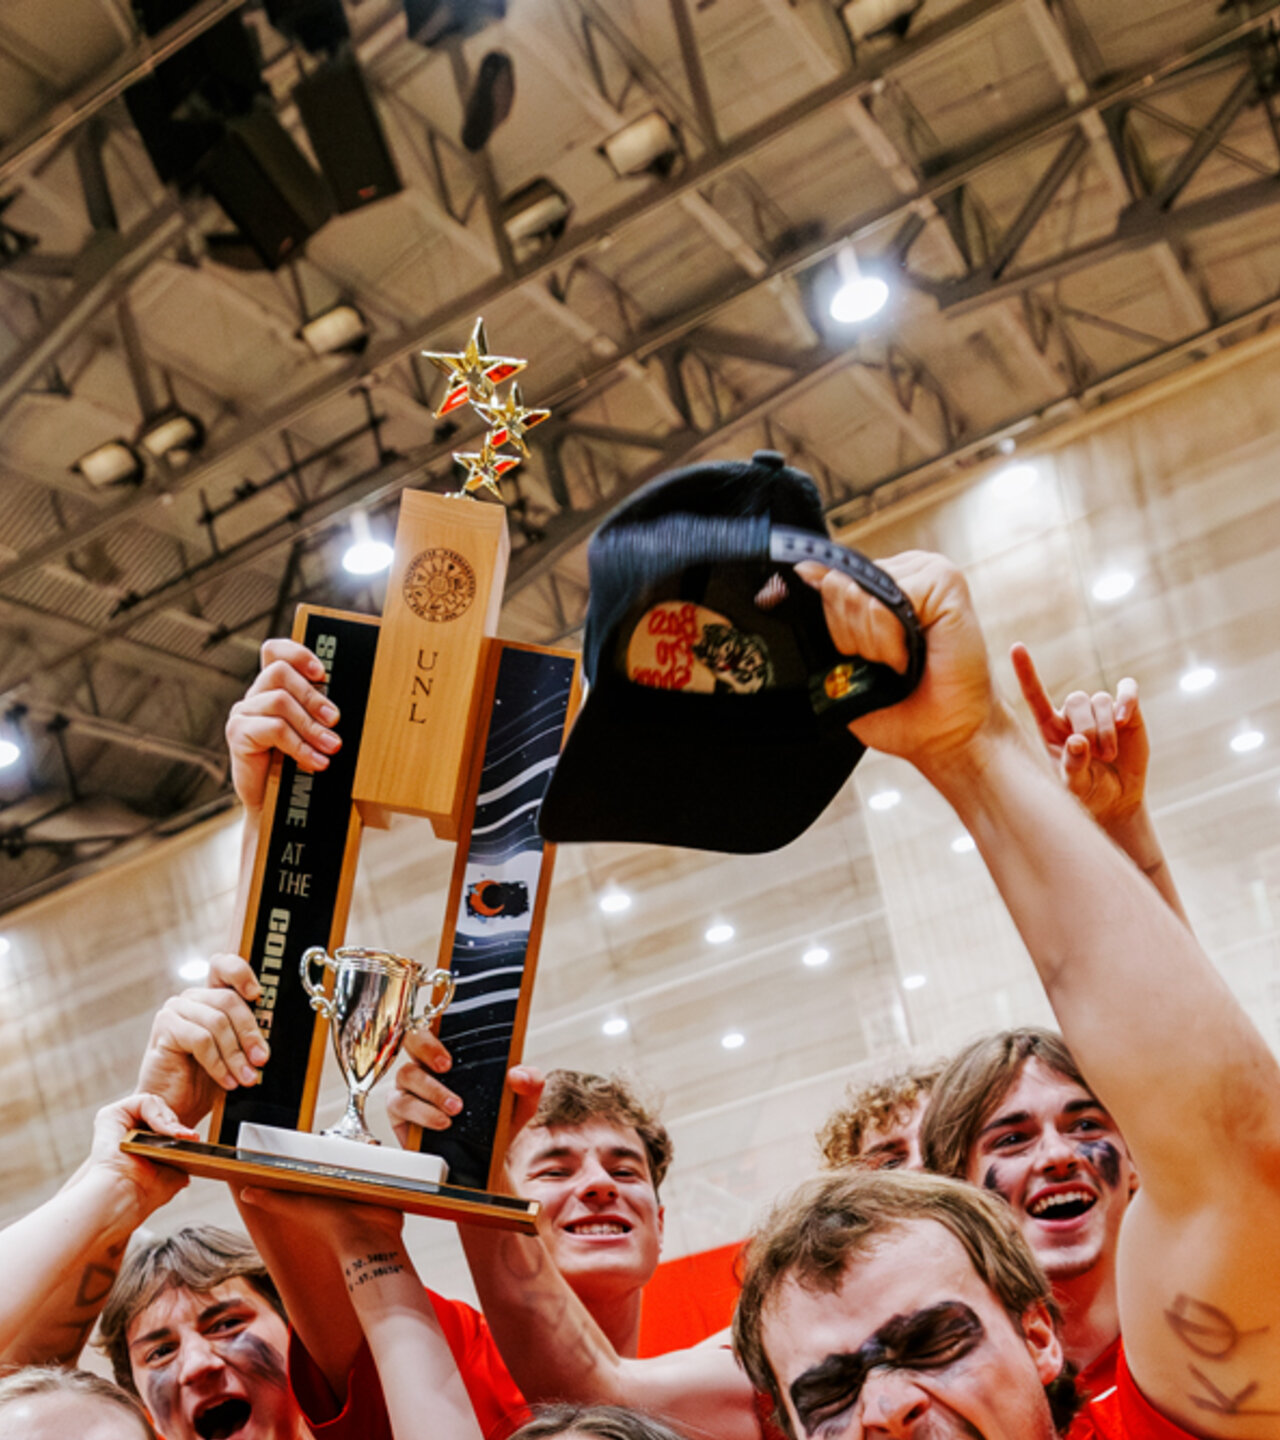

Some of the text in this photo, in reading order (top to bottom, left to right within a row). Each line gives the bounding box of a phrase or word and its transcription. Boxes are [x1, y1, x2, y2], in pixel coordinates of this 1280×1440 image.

[408, 649, 438, 724] UNL
[280, 841, 306, 867] AT
[278, 868, 313, 898] THE
